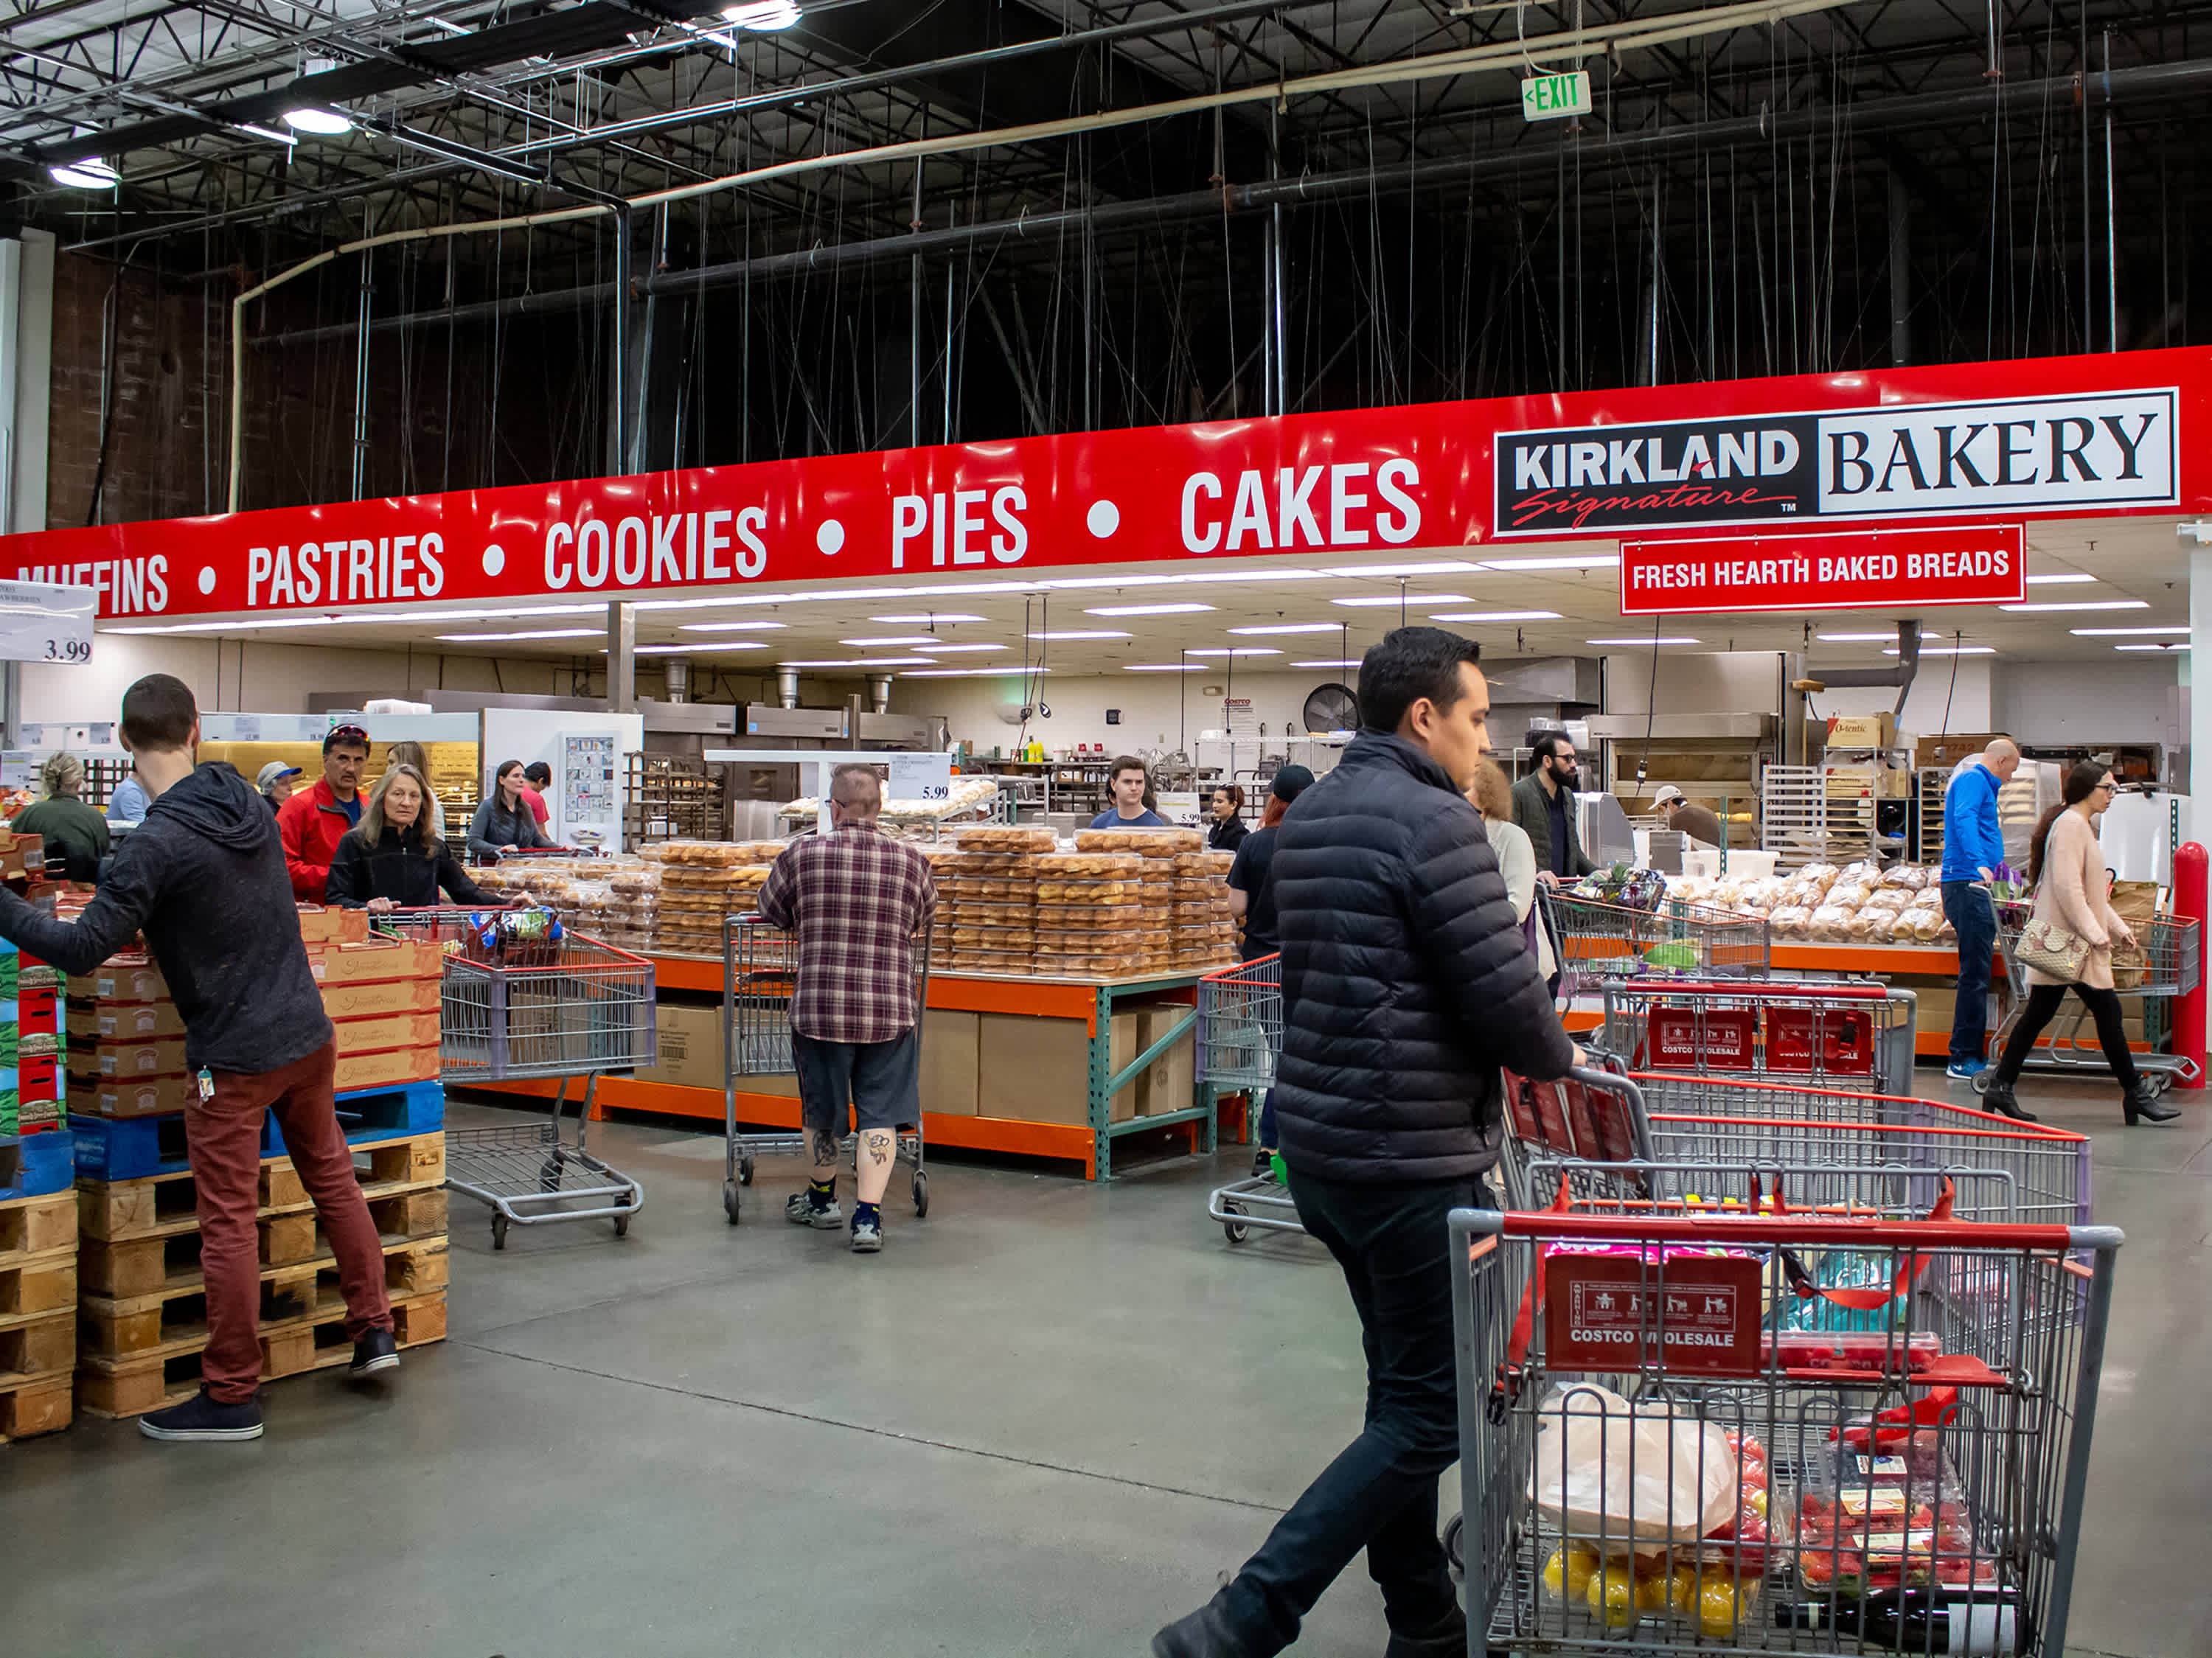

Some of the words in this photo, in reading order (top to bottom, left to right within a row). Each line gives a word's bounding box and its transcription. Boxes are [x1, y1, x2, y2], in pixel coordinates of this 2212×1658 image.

[1534, 74, 1578, 111] EXIT
[1515, 431, 1799, 490] KIRKLAND
[1827, 414, 2158, 495] BAKERY
[1512, 484, 1798, 530] Signature
[1781, 503, 1796, 512] TM
[18, 554, 169, 616] FINS
[247, 532, 444, 605] PASTRIES
[544, 507, 768, 589] COOKIES
[892, 486, 1028, 568] PIES
[1181, 459, 1421, 554] CAKES
[1633, 562, 1690, 589] FRESH
[1715, 558, 1809, 586] HEARTH
[1819, 554, 1899, 582] BAKED
[1907, 551, 2009, 579] BREADS
[44, 639, 91, 662] 3.99
[922, 786, 949, 799] 5.99
[1180, 813, 1200, 822] 5.99
[1661, 1046, 1694, 1054] COSTCO
[1571, 1328, 1635, 1343] COSTCO
